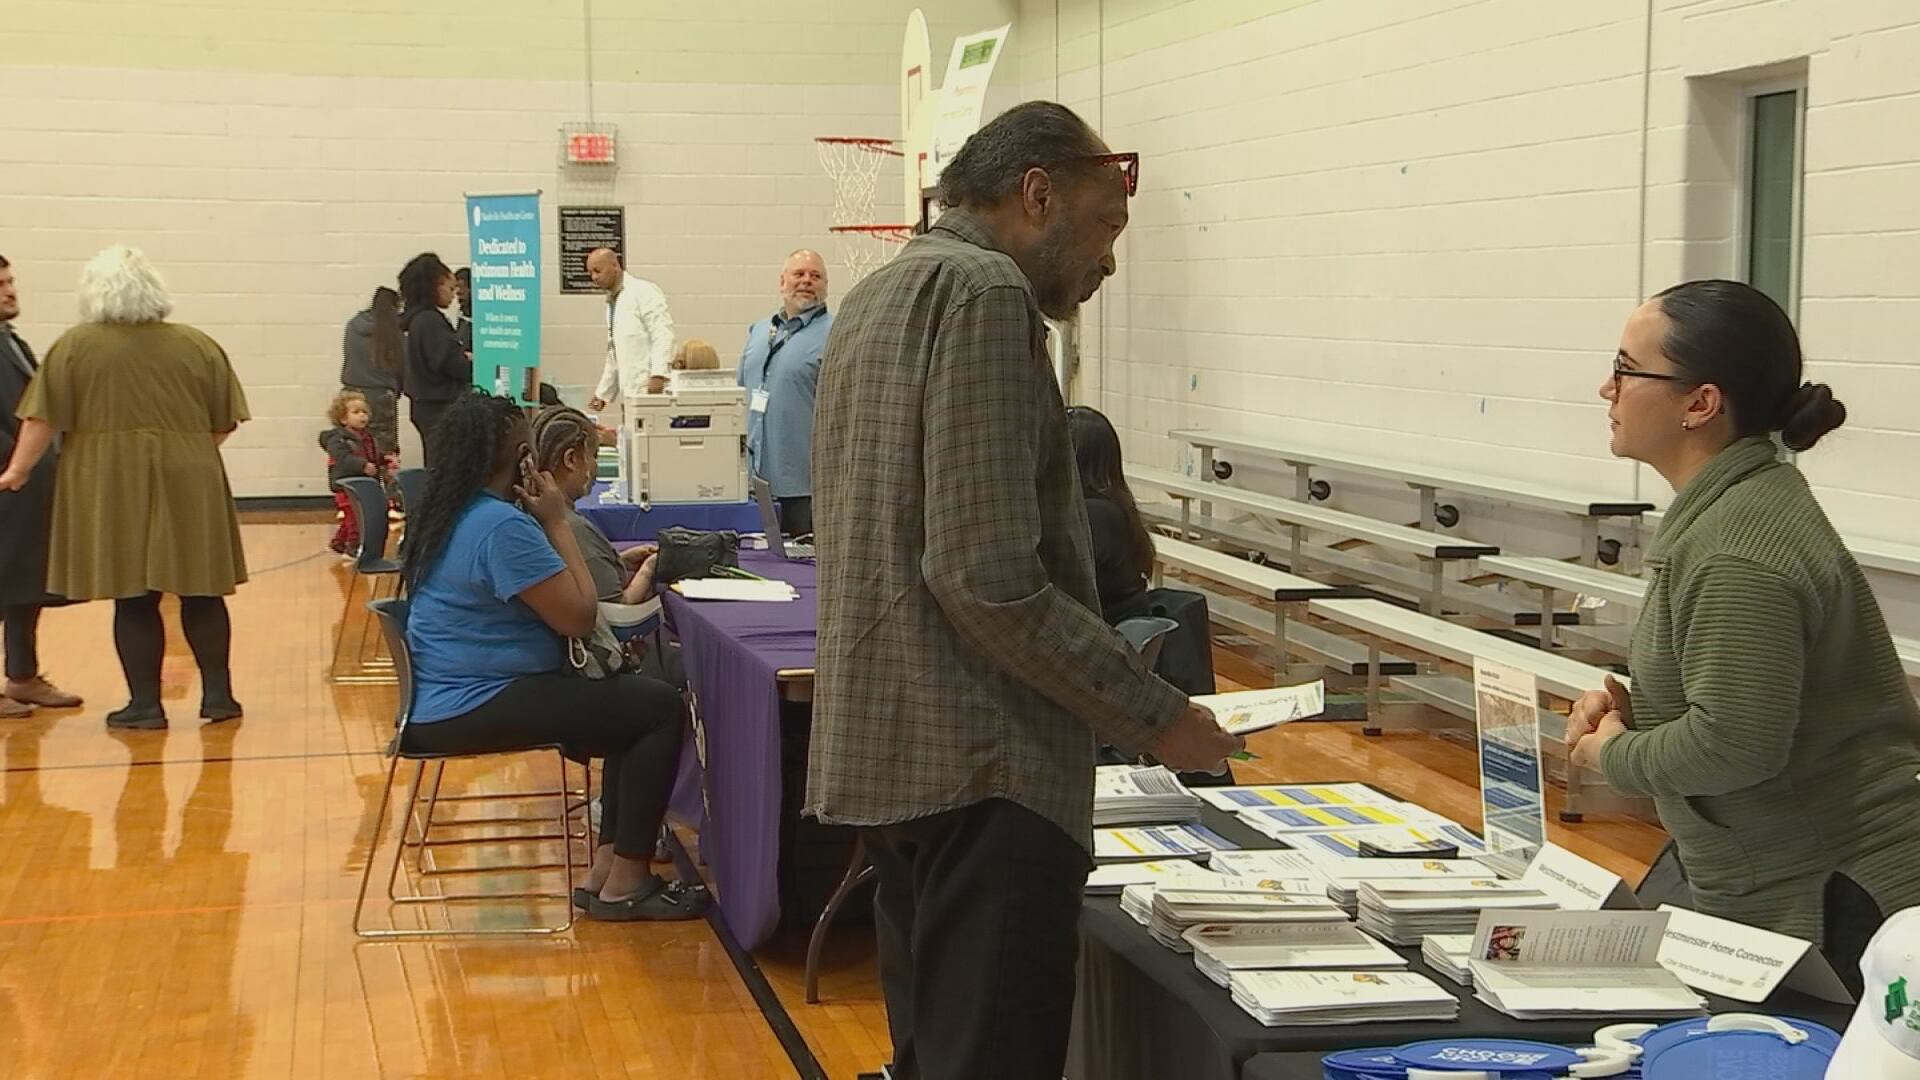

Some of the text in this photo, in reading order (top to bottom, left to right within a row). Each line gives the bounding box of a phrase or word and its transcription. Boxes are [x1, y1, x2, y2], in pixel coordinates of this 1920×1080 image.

[478, 237, 527, 255] Dedicated to
[471, 260, 536, 282] Optimum Health
[478, 283, 494, 301] and
[1709, 940, 1736, 956] Home
[1735, 947, 1784, 968] Connection
